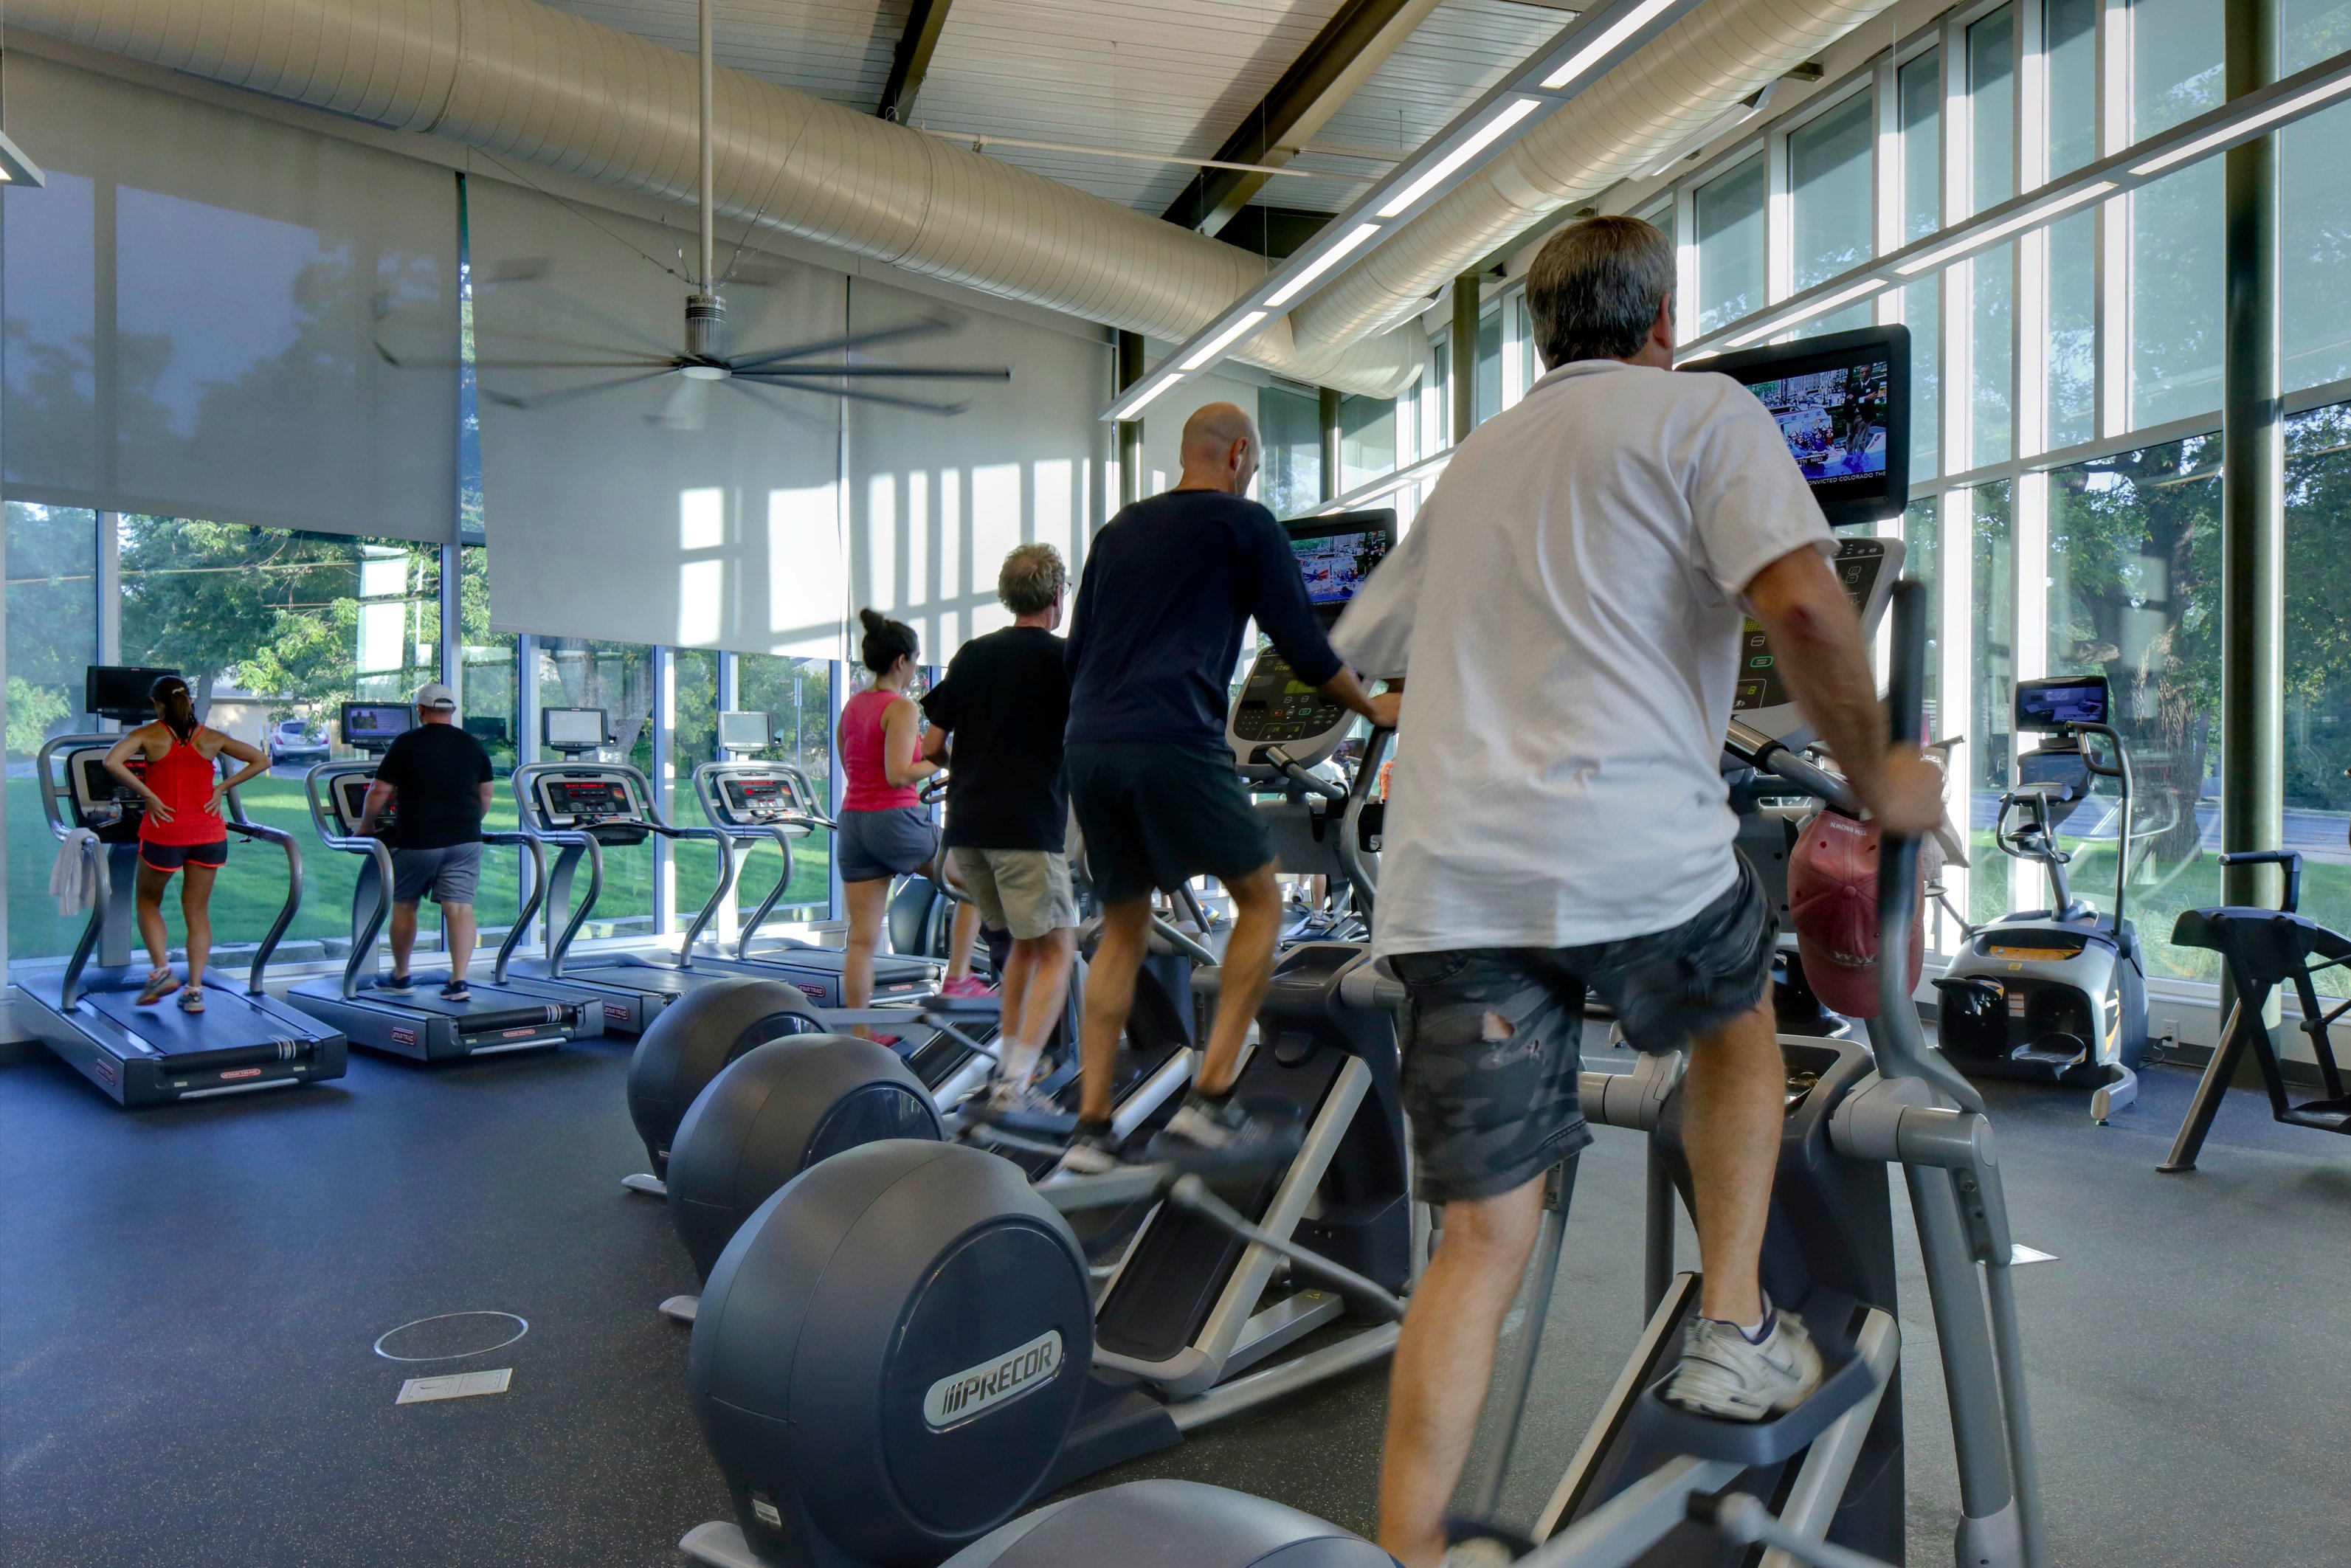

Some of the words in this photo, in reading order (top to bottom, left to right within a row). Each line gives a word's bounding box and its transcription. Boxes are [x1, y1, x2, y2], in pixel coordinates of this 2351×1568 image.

[1806, 477, 1837, 486] ONVICTED
[1839, 472, 1874, 482] COLORADO
[1830, 821, 1854, 833] BROWN
[961, 1340, 1052, 1409] PRECOR
